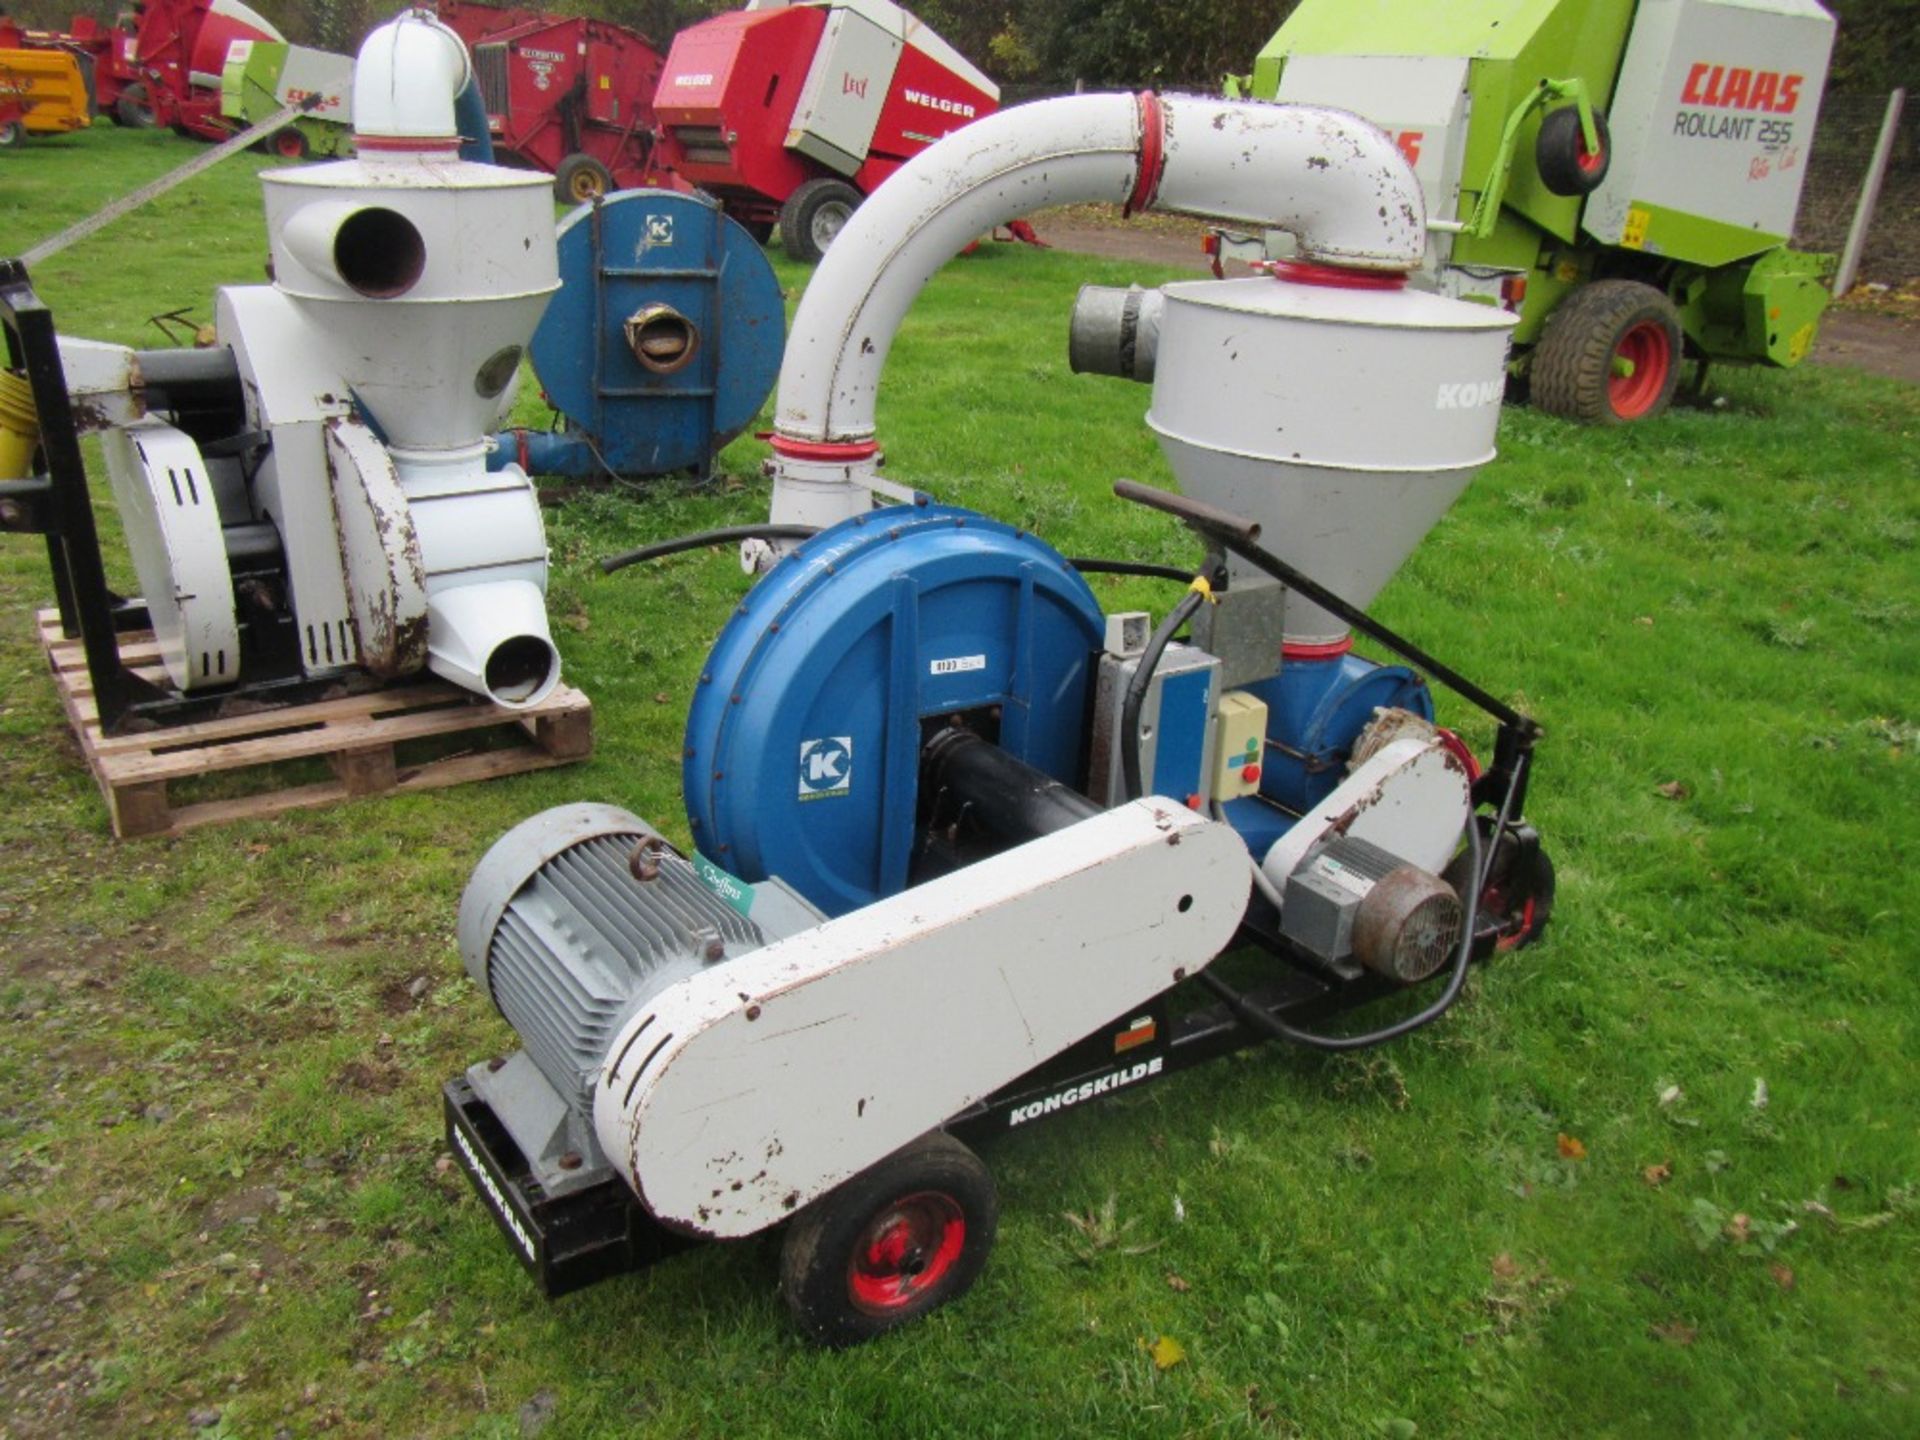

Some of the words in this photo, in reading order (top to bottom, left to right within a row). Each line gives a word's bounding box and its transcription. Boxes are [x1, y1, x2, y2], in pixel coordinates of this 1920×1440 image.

[904, 89, 976, 118] WELGER
[1681, 63, 1803, 114] CLAAS
[1673, 112, 1755, 140] ROLLANT
[1758, 119, 1793, 144] 255
[1009, 1057, 1163, 1126] KONGSKILDE
